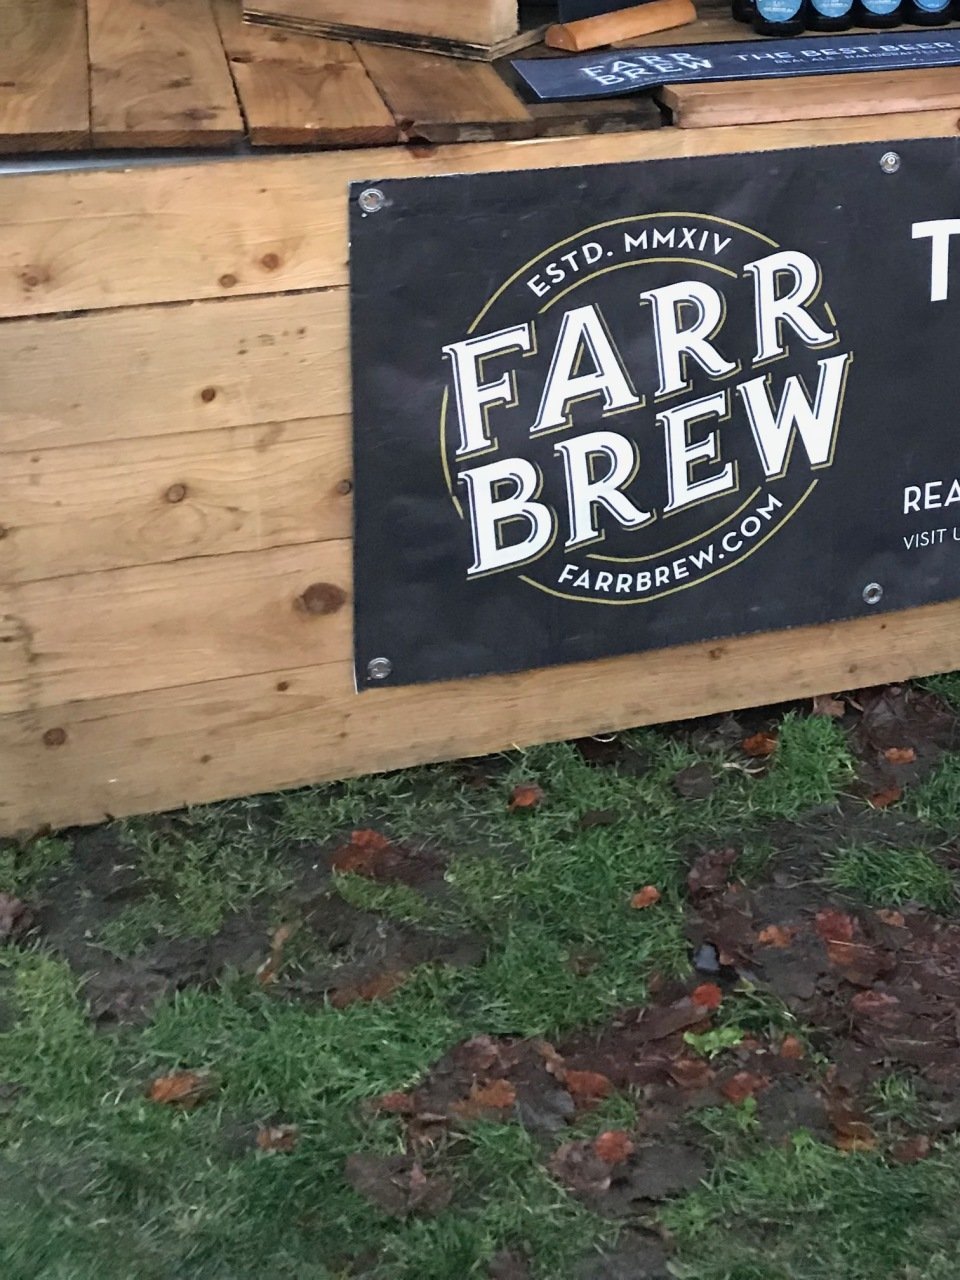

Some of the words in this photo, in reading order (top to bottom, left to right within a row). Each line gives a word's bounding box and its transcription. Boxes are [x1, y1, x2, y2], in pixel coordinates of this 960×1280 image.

[580, 52, 702, 78] FARR
[595, 57, 713, 87] BREW
[735, 50, 794, 61] THE
[799, 45, 870, 57] BEST
[878, 41, 954, 52] BEER
[527, 242, 614, 298] ESTD.
[624, 227, 732, 255] MMXIV
[442, 250, 838, 458] FARR
[457, 353, 851, 577] BREW
[558, 493, 783, 593] FARRBREW.COM
[903, 528, 947, 550] VISIT
